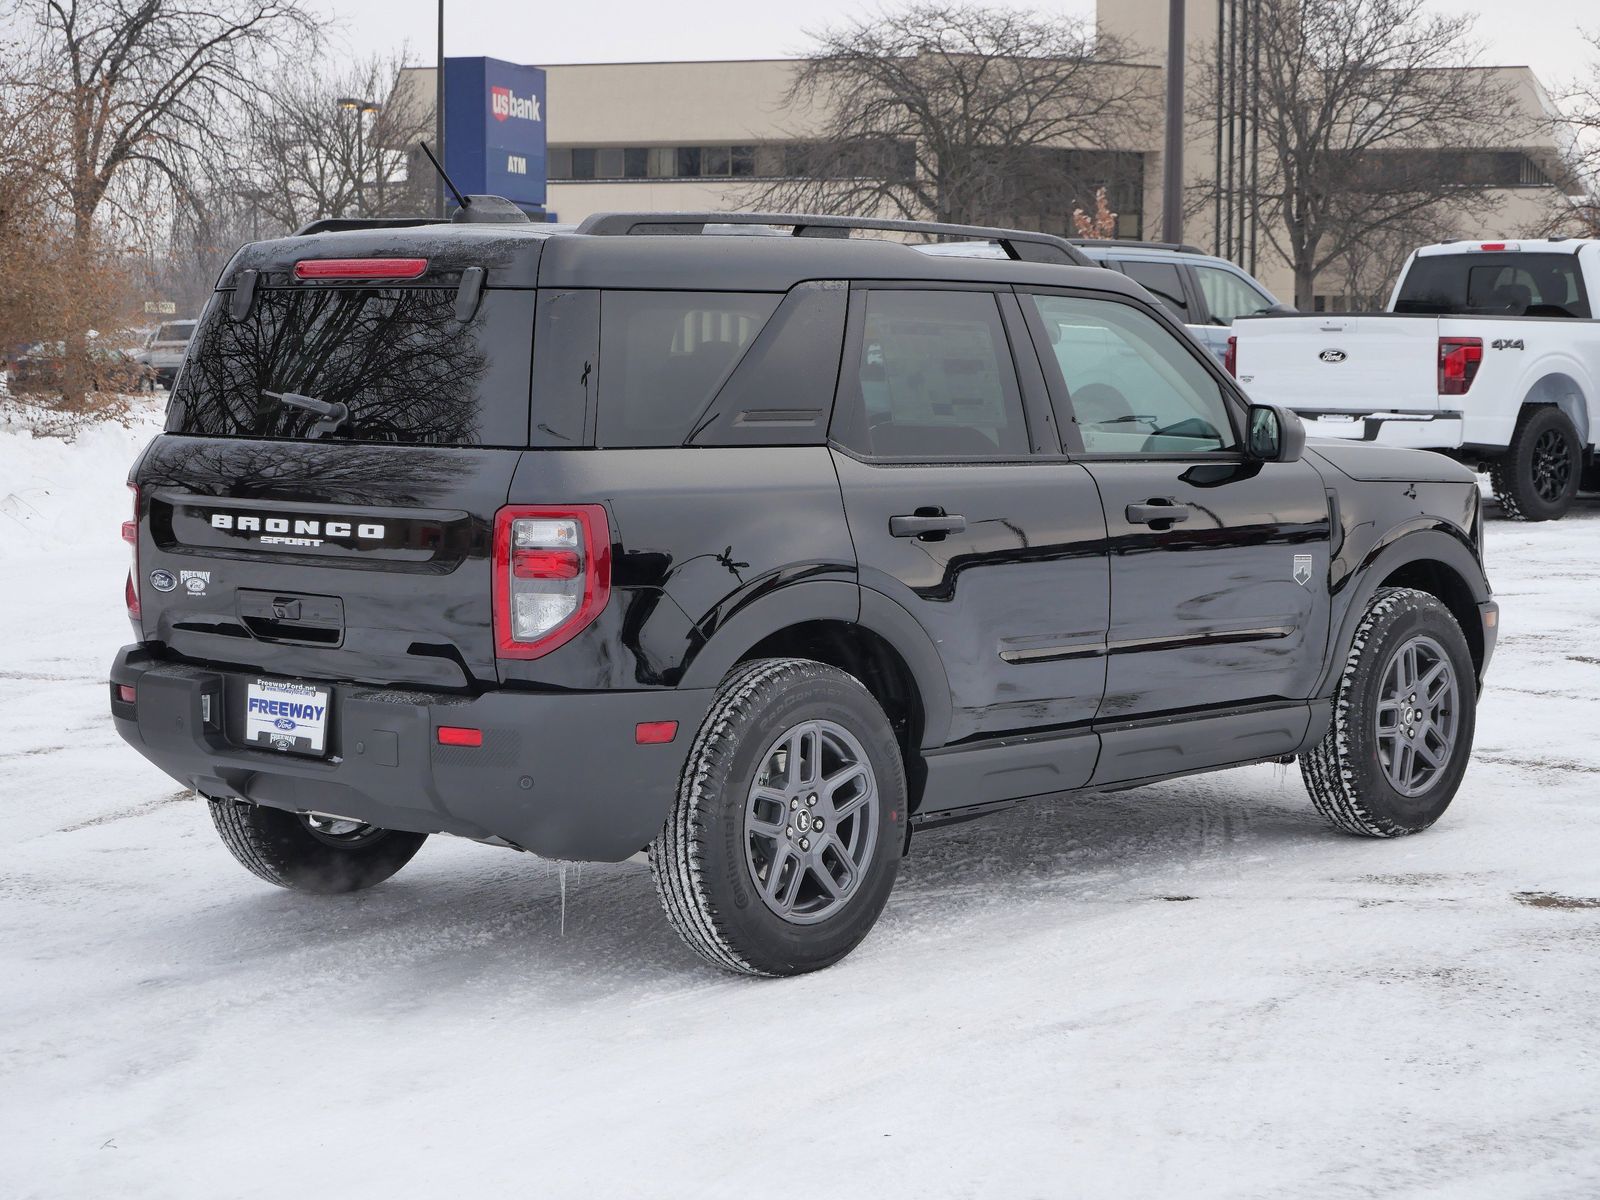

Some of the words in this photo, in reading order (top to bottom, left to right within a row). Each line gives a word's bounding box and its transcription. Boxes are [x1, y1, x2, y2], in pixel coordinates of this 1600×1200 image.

[508, 155, 526, 175] ATM
[1322, 351, 1342, 361] Ford
[211, 514, 385, 539] BRONCO
[260, 535, 324, 547] SPORT
[153, 573, 170, 587] Ford
[180, 570, 210, 584] FREEWAY
[257, 679, 316, 691] FreewayFord.net
[248, 698, 325, 721] FREEWAY
[277, 720, 294, 730] Ford
